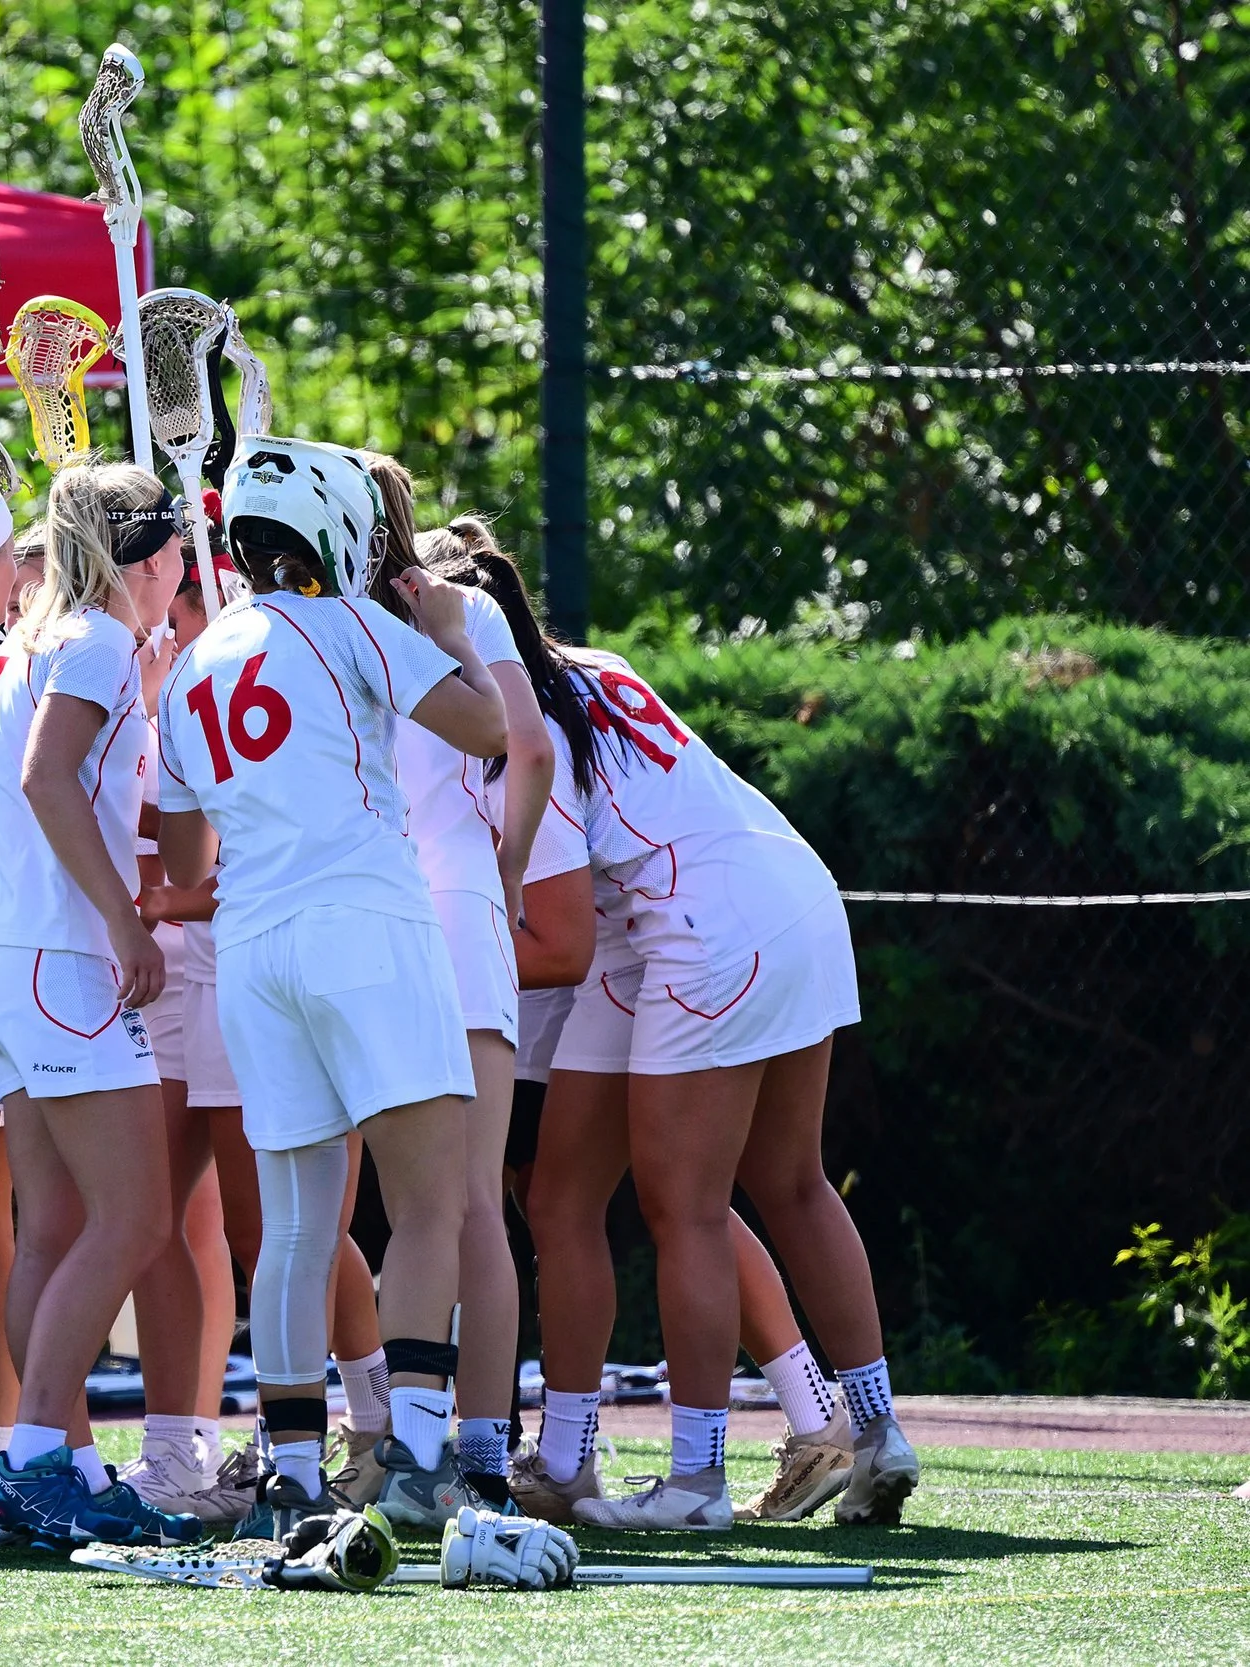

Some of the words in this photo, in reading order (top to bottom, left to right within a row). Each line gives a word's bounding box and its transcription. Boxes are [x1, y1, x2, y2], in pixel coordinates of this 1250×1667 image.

[256, 437, 293, 447] cascade
[106, 511, 125, 520] AIT
[131, 511, 158, 521] GAIT
[186, 651, 293, 785] 16
[588, 671, 690, 774] 19
[41, 1064, 77, 1073] KUKRI
[779, 1484, 796, 1502] new
[793, 1452, 825, 1486] balance
